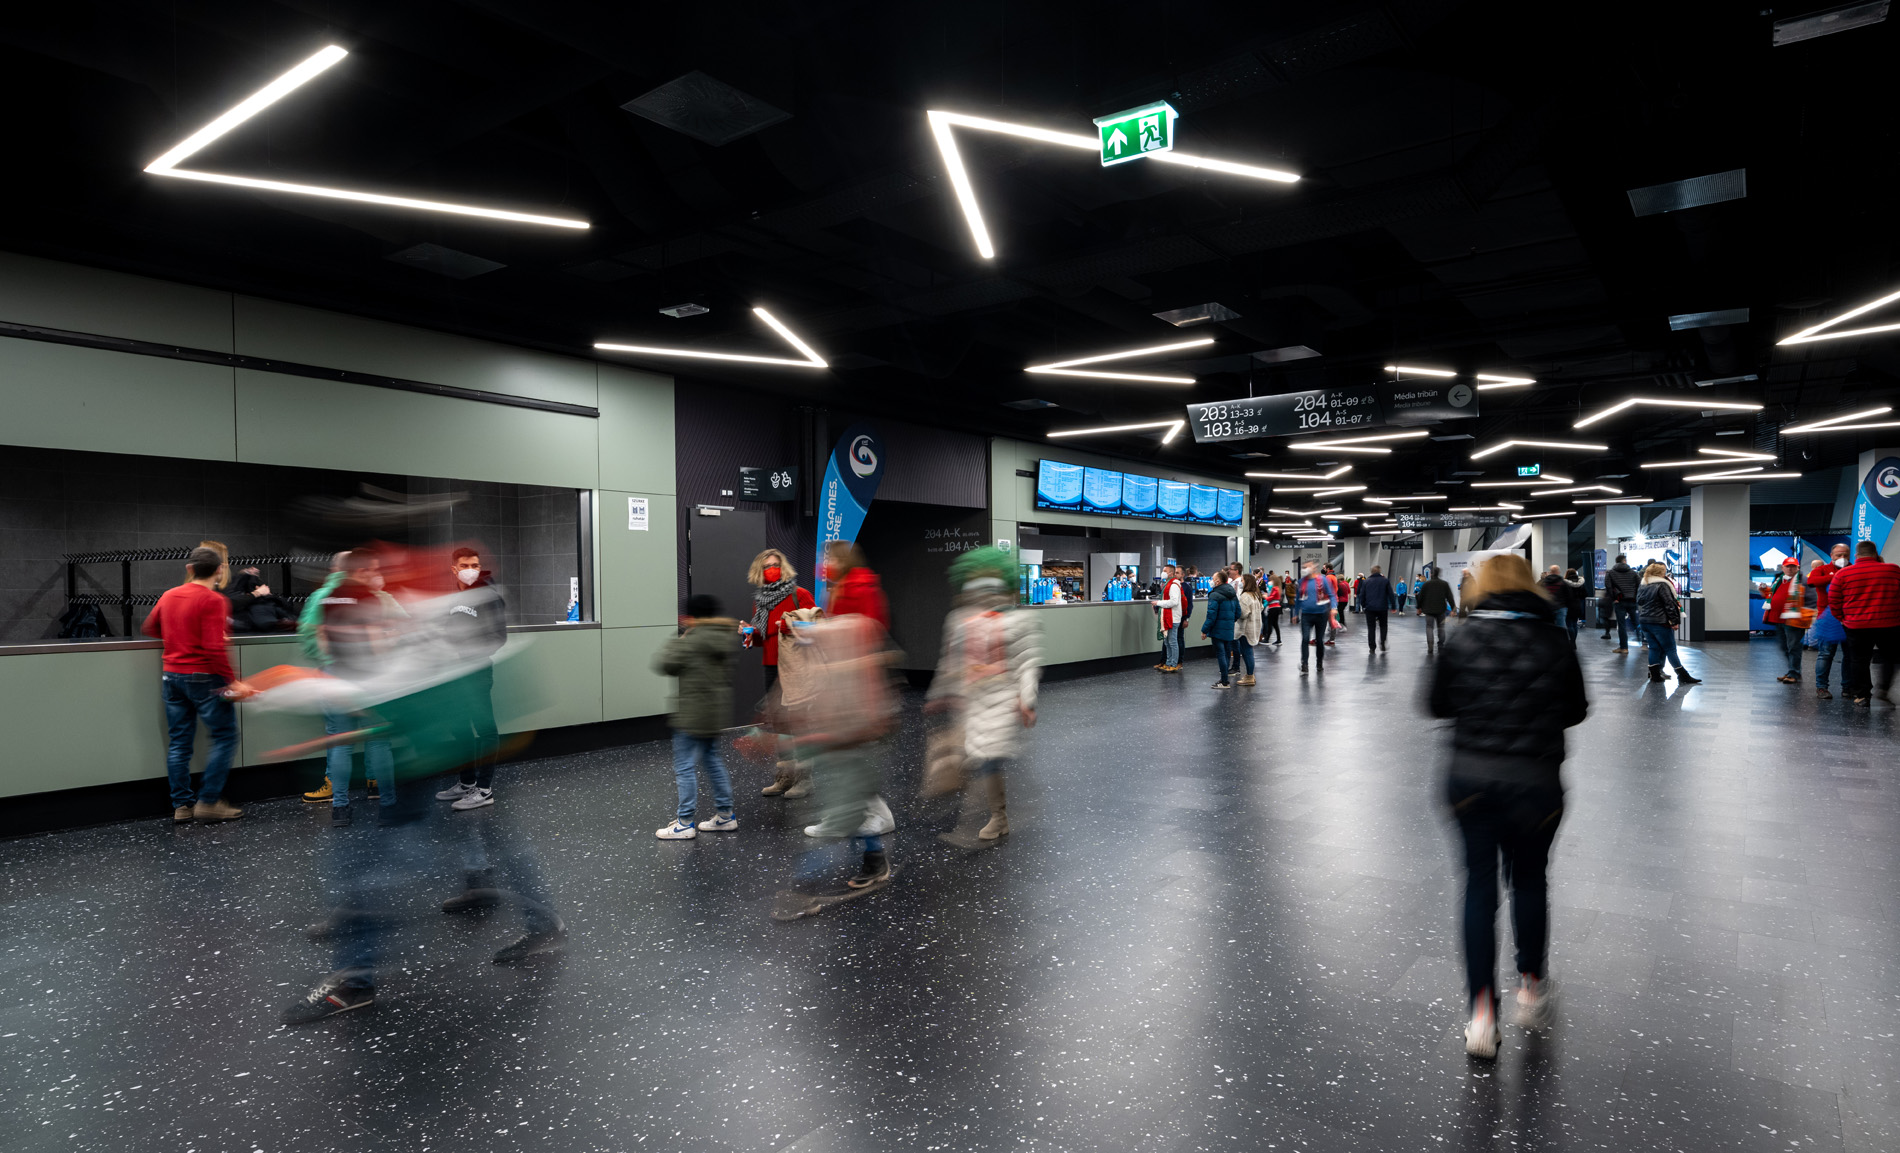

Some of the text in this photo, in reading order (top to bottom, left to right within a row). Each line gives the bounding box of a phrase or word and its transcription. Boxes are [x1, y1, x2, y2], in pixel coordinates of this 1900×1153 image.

[1294, 394, 1358, 412] 204 01-09
[1394, 389, 1438, 400] Média tribün
[1199, 405, 1254, 422] 203 13-33
[1299, 411, 1363, 429] 104 01-07
[1203, 421, 1259, 438] 103 16-30
[826, 478, 838, 531] GAMES.
[832, 513, 843, 541] ORE.
[1401, 520, 1415, 528] 104
[1857, 501, 1867, 538] GAMES.
[924, 529, 941, 539] 204
[943, 527, 961, 538] A-K
[944, 541, 962, 552] 104
[963, 540, 980, 551] A-S
